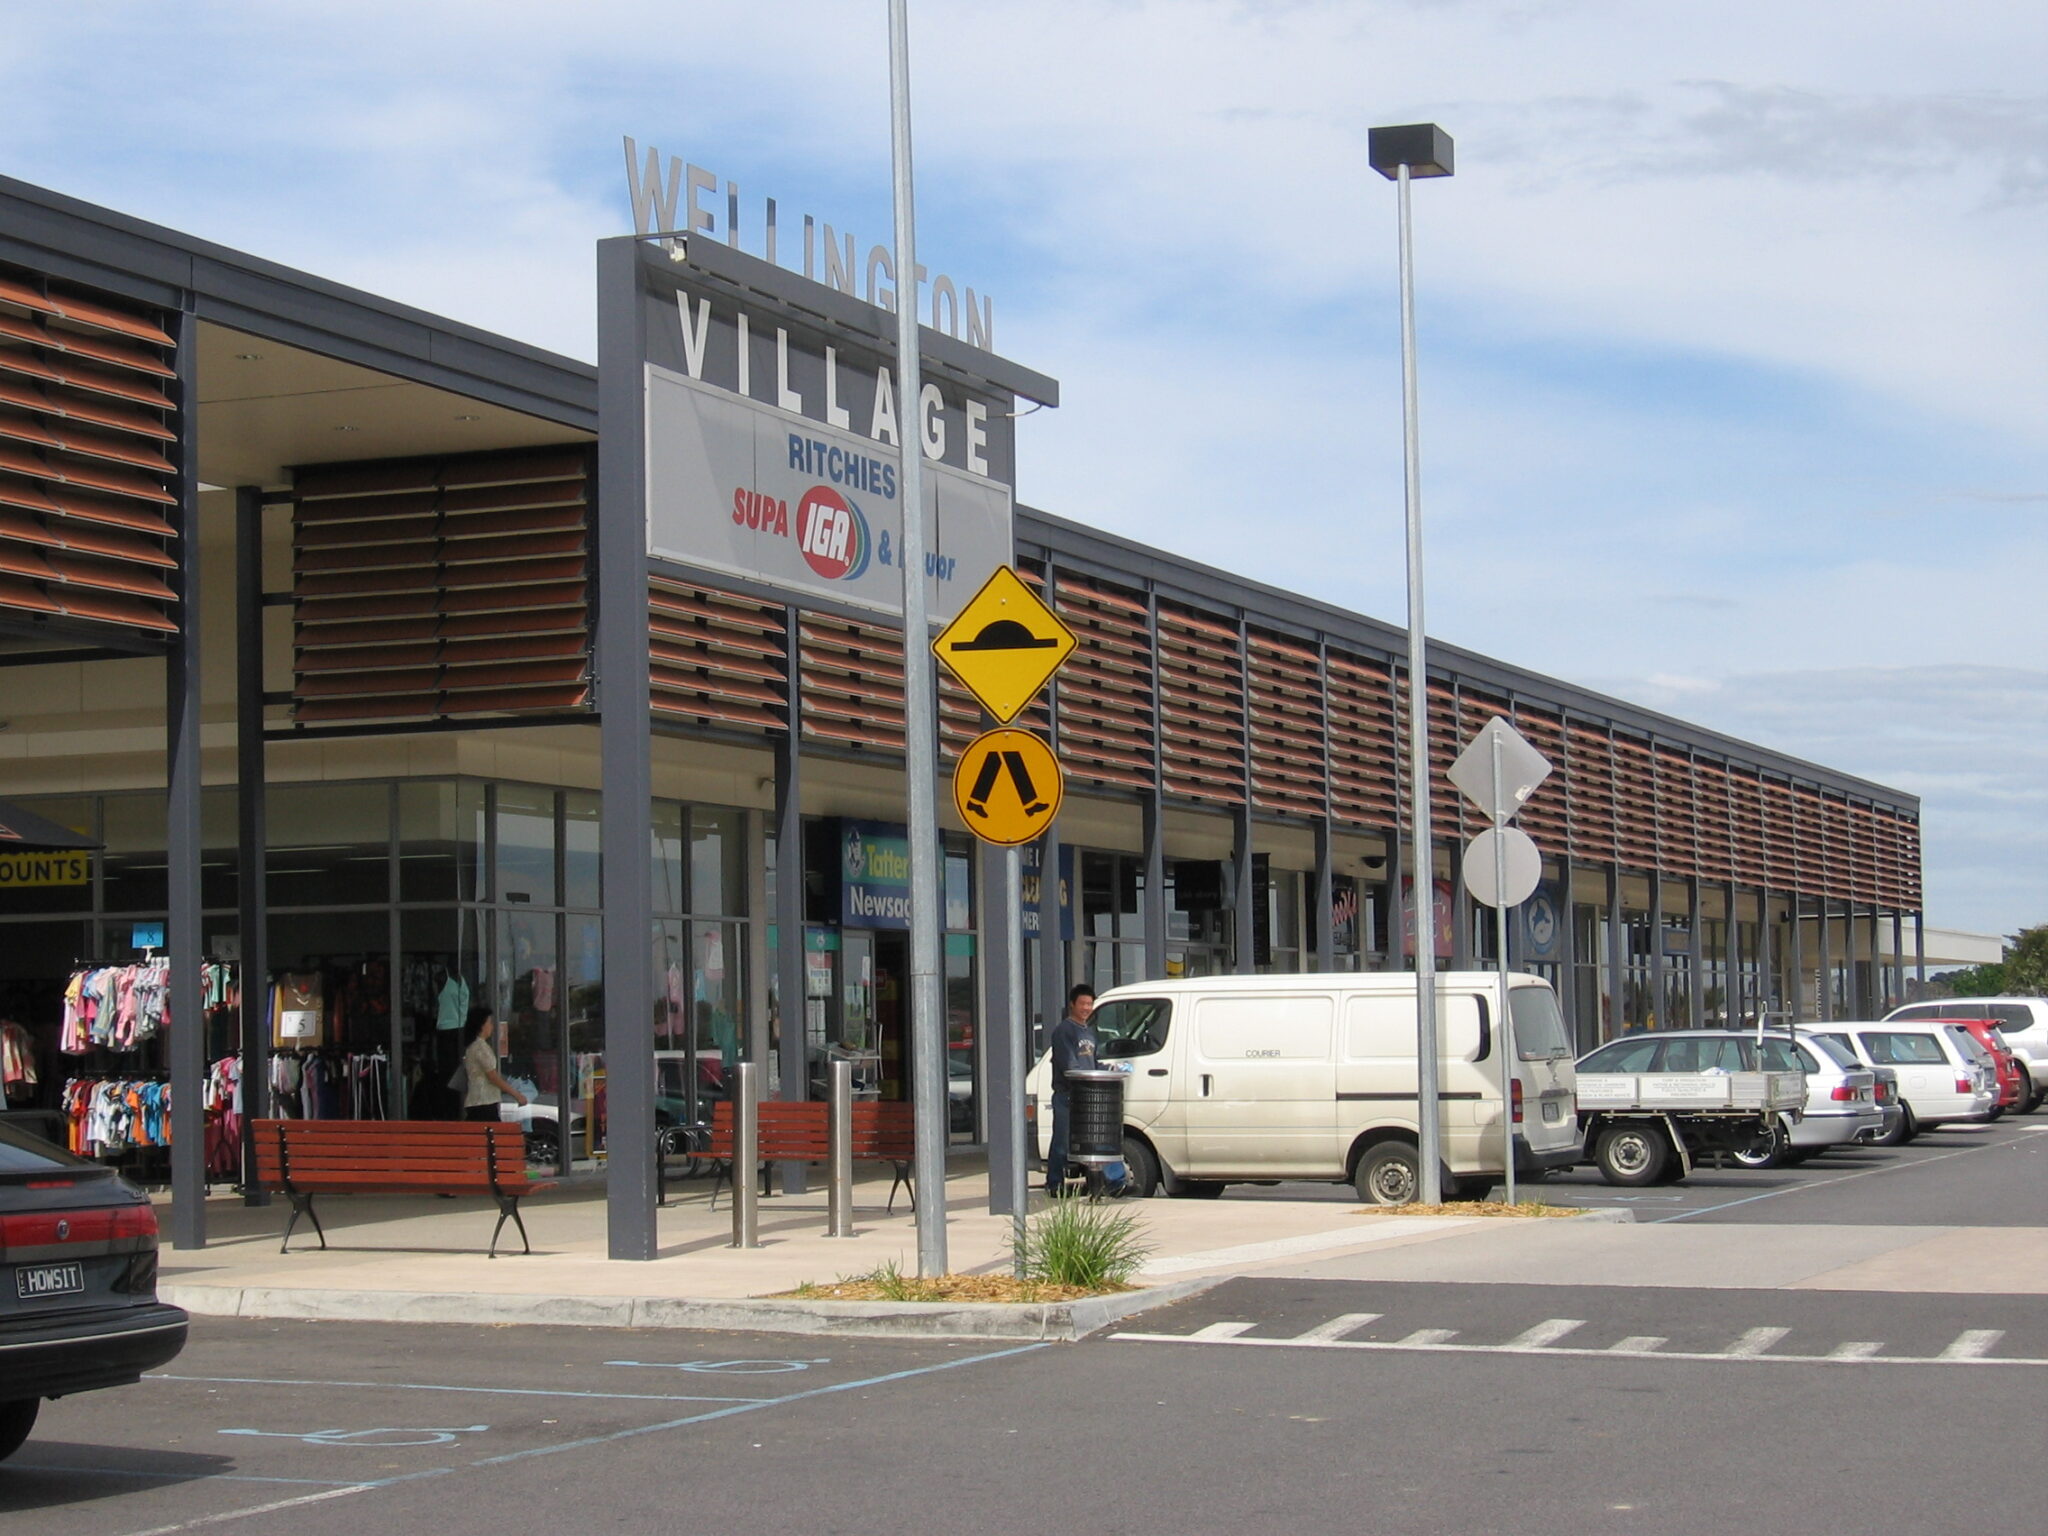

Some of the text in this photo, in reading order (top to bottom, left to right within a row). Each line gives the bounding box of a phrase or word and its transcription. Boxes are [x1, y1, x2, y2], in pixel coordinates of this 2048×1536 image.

[623, 135, 992, 353] WELLINGON
[676, 289, 988, 477] VILLAGE
[789, 433, 896, 500] RITCHIES
[732, 487, 788, 538] SUPA
[802, 502, 850, 562] IGA
[878, 530, 956, 582] & uor
[298, 1019, 306, 1033] 5
[28, 1267, 76, 1292] HOWSIT
